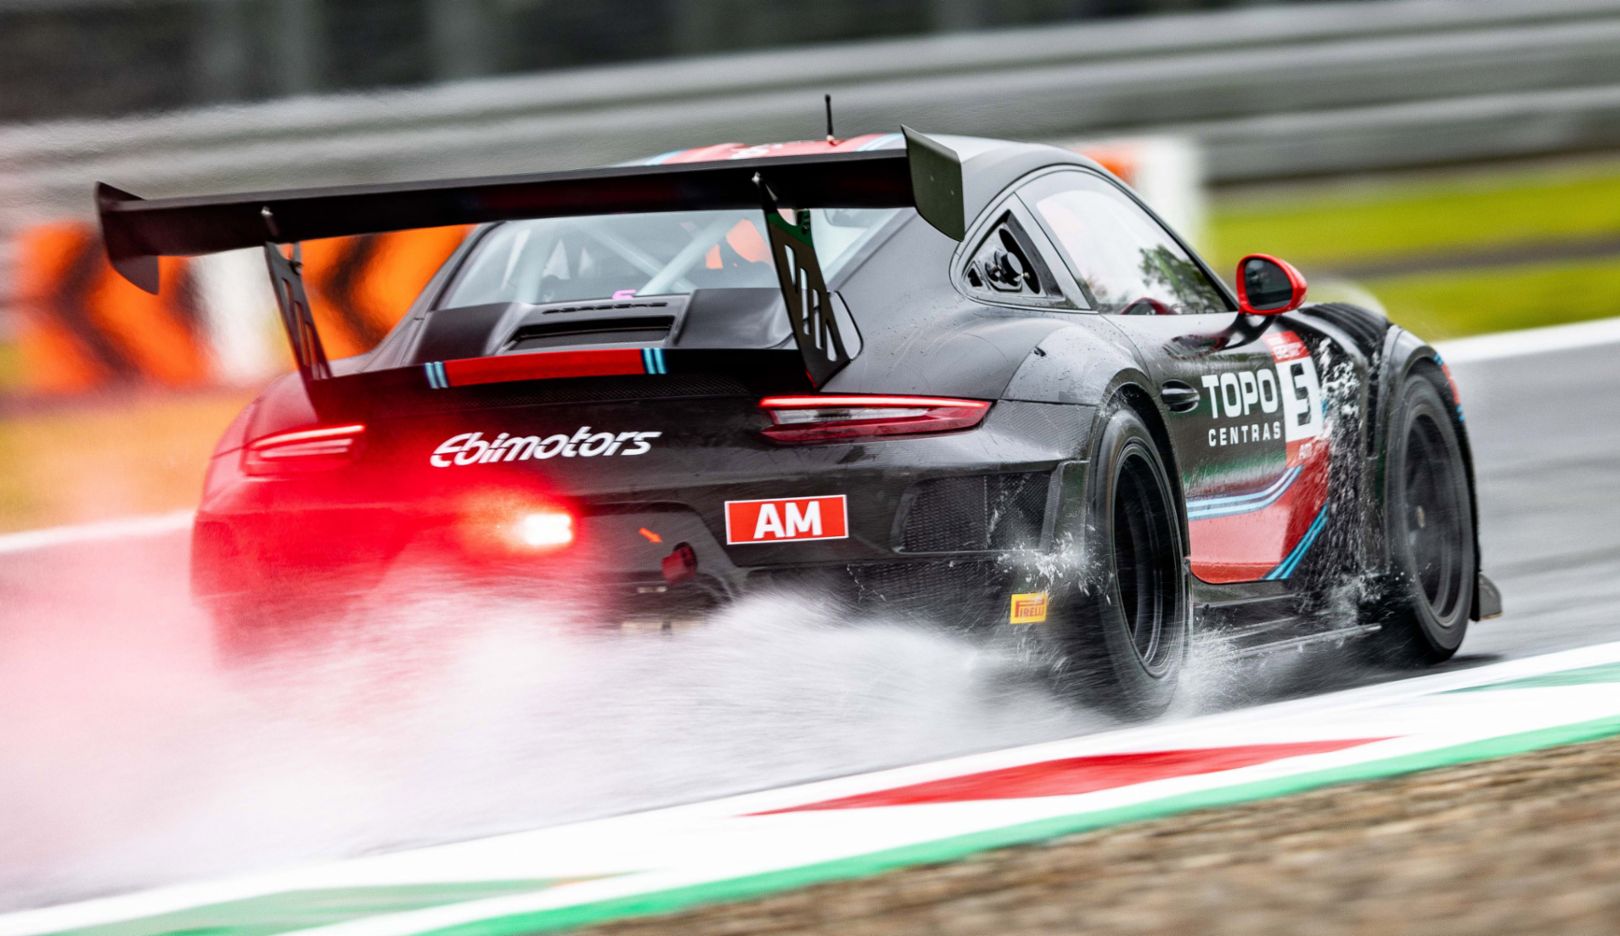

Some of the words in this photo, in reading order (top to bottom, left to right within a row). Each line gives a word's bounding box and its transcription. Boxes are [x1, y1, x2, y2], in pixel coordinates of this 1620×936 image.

[1201, 368, 1279, 419] TOPO
[1290, 362, 1312, 426] 5
[1208, 421, 1281, 447] CENTRAS
[753, 500, 823, 539] AM
